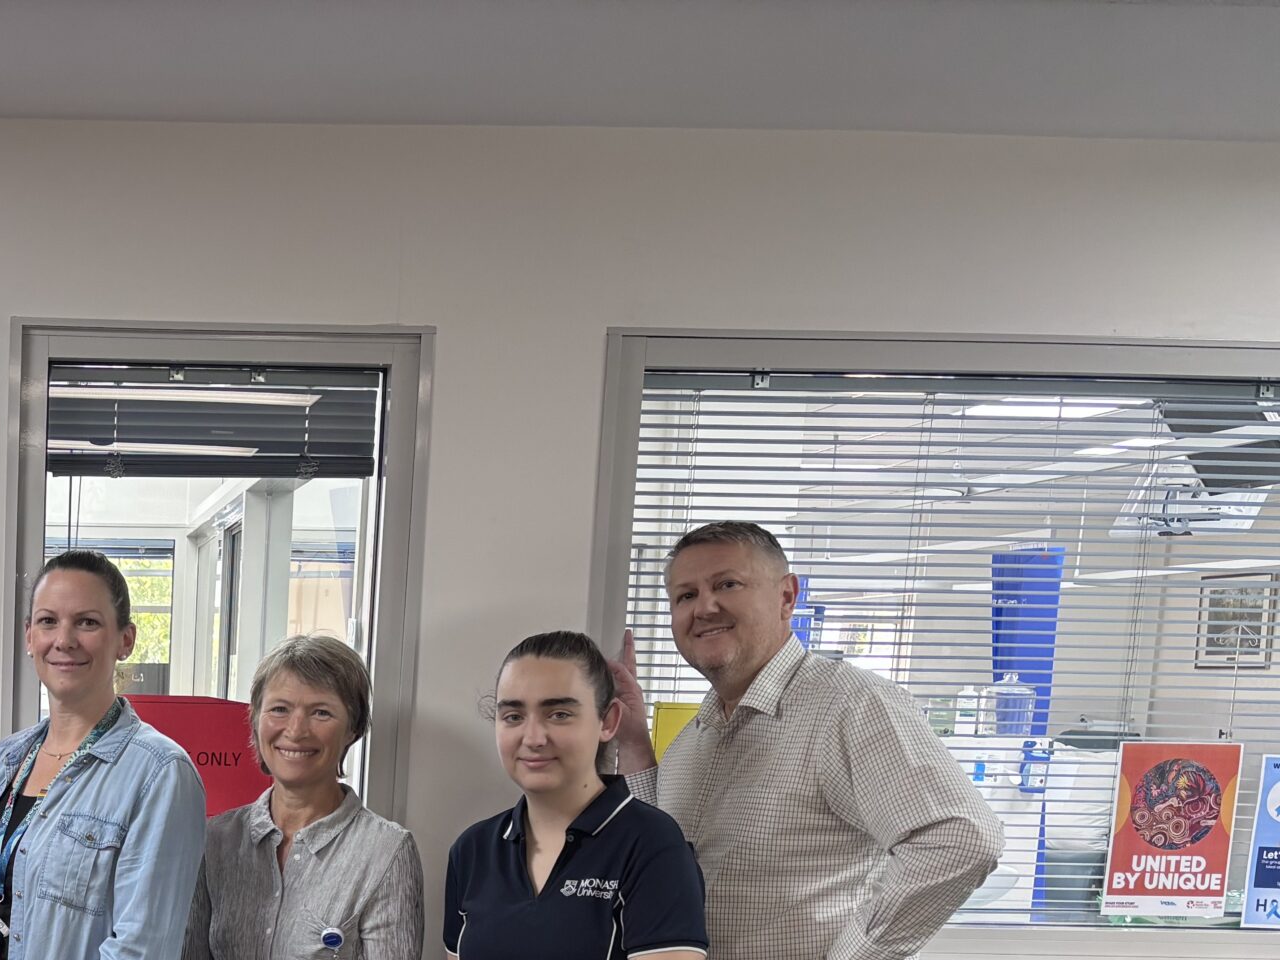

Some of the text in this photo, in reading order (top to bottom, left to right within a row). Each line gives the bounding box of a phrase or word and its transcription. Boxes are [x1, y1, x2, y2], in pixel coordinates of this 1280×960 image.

[196, 751, 242, 767] ONLY
[1131, 855, 1207, 873] UNITED
[580, 878, 619, 889] MONASH
[1112, 872, 1223, 891] BY UNIQUE
